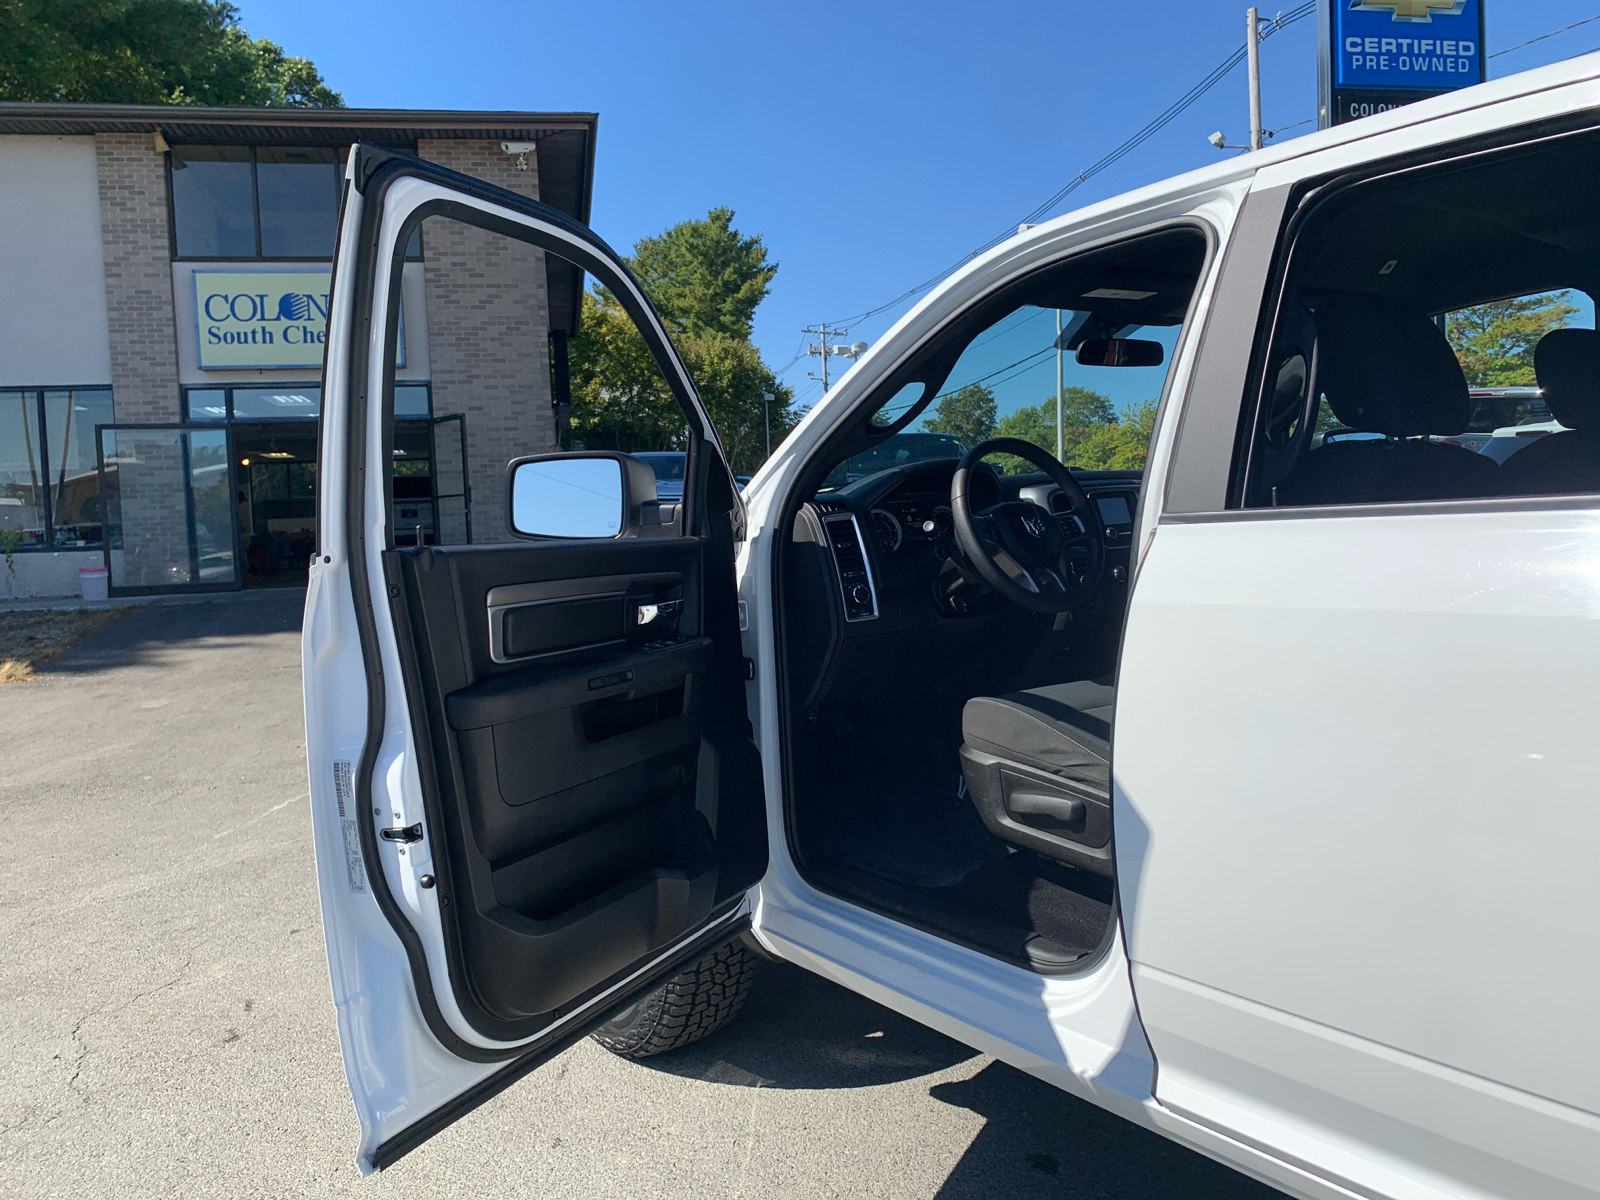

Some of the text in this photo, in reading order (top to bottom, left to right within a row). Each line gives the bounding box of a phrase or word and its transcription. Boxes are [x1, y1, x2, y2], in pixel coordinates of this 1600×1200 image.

[1345, 36, 1475, 56] CERTIFIED
[1352, 56, 1469, 72] PRE-OWNED
[208, 325, 274, 345] South
